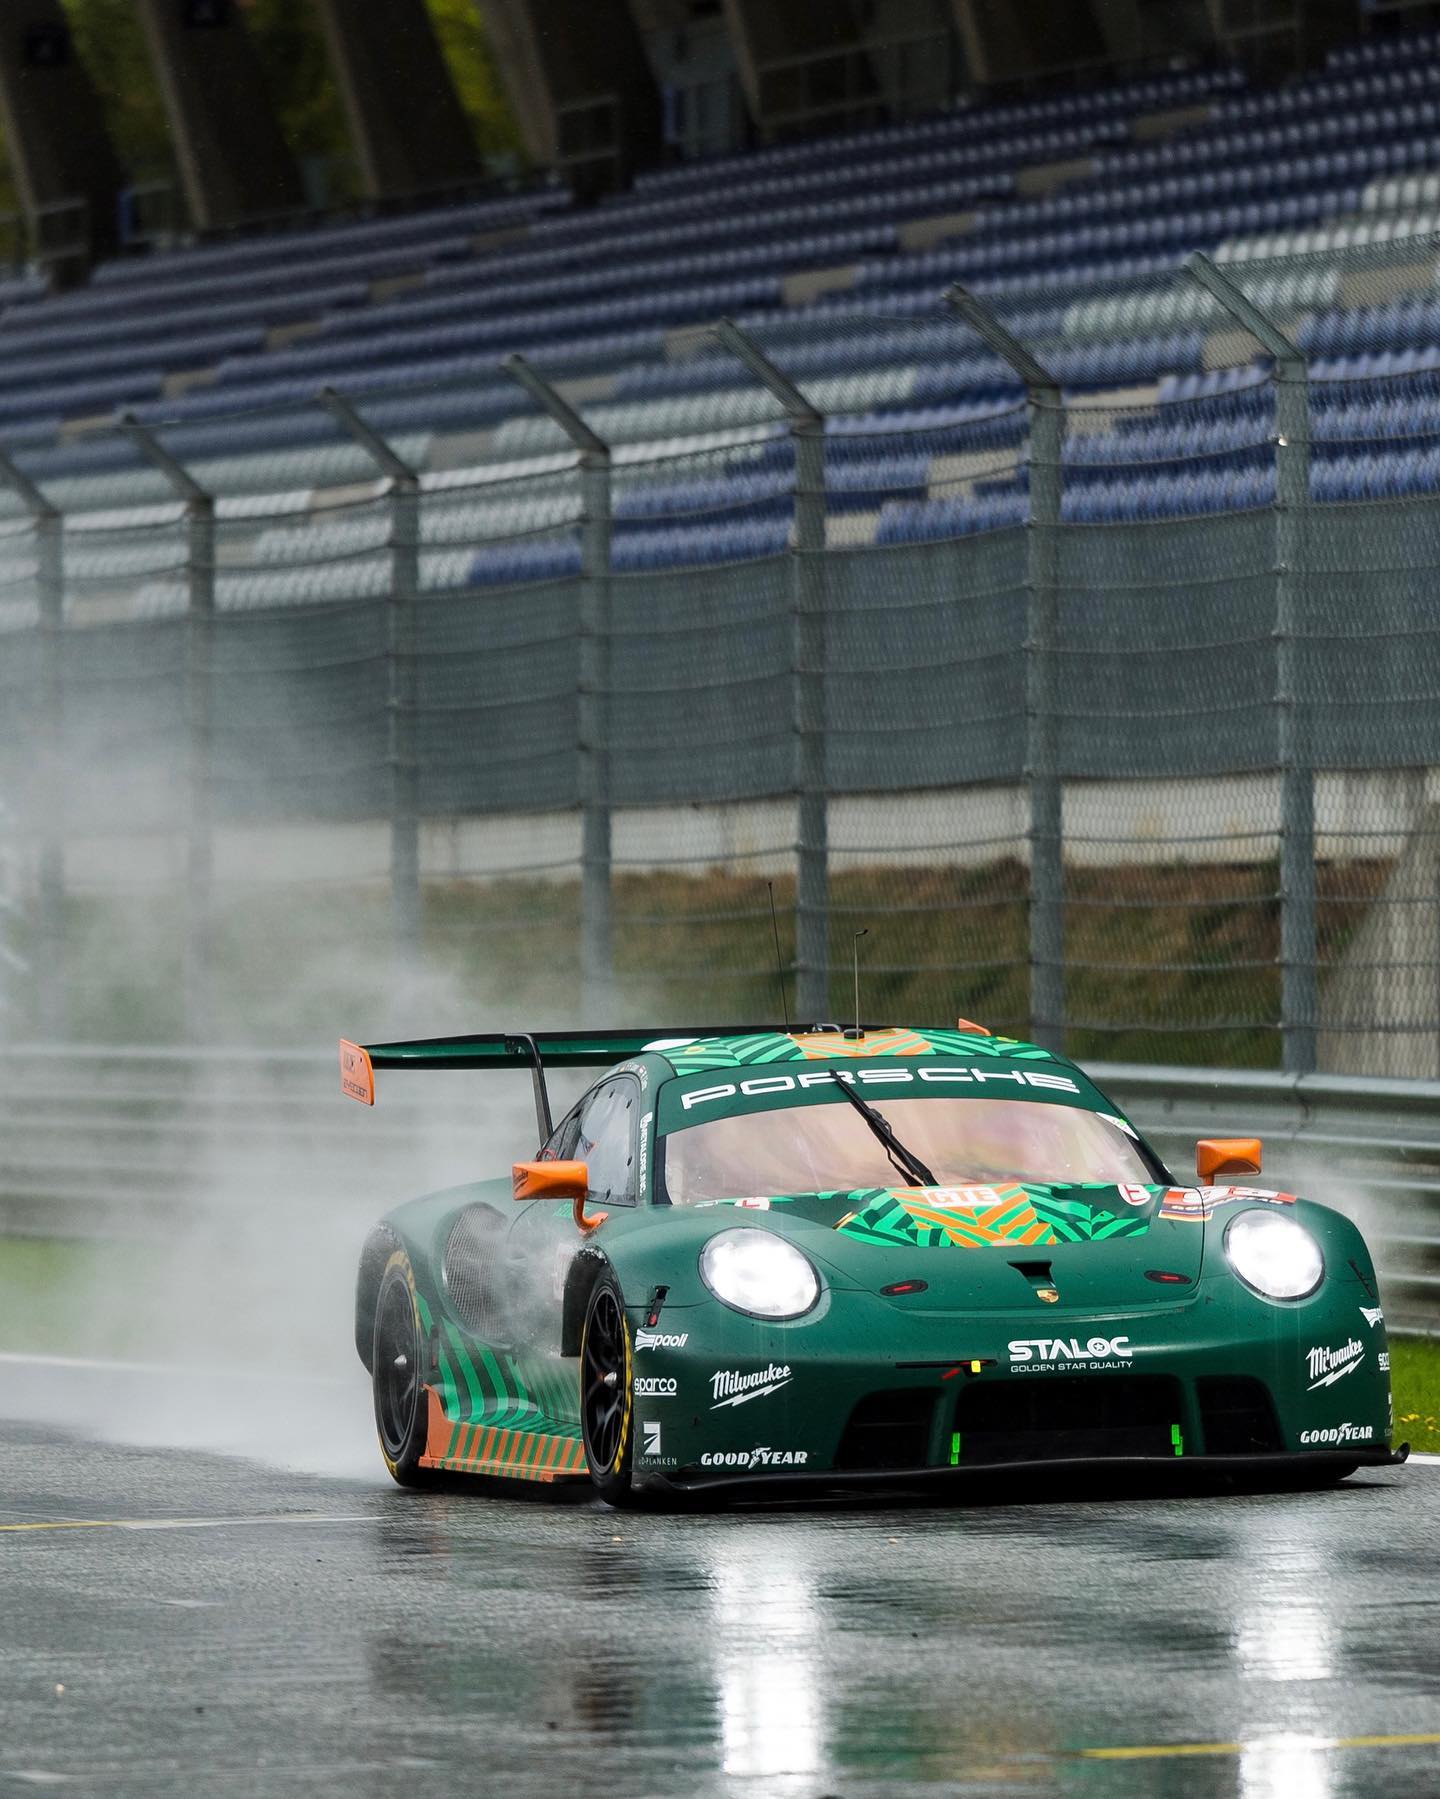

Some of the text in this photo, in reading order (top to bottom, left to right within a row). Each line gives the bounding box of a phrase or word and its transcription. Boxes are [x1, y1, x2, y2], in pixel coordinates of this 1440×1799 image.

[681, 1068, 1080, 1110] PORSCHE
[653, 1333, 689, 1351] paoli
[1007, 1336, 1133, 1361] STALOC
[1010, 1360, 1133, 1373] GOLDEN STAR QUALITY
[1305, 1338, 1364, 1380] Milwaukee
[634, 1377, 677, 1396] sparco
[709, 1363, 792, 1400] Milwaukee
[1300, 1424, 1373, 1445] GOODYEAR
[700, 1448, 808, 1468] GOODYEAR
